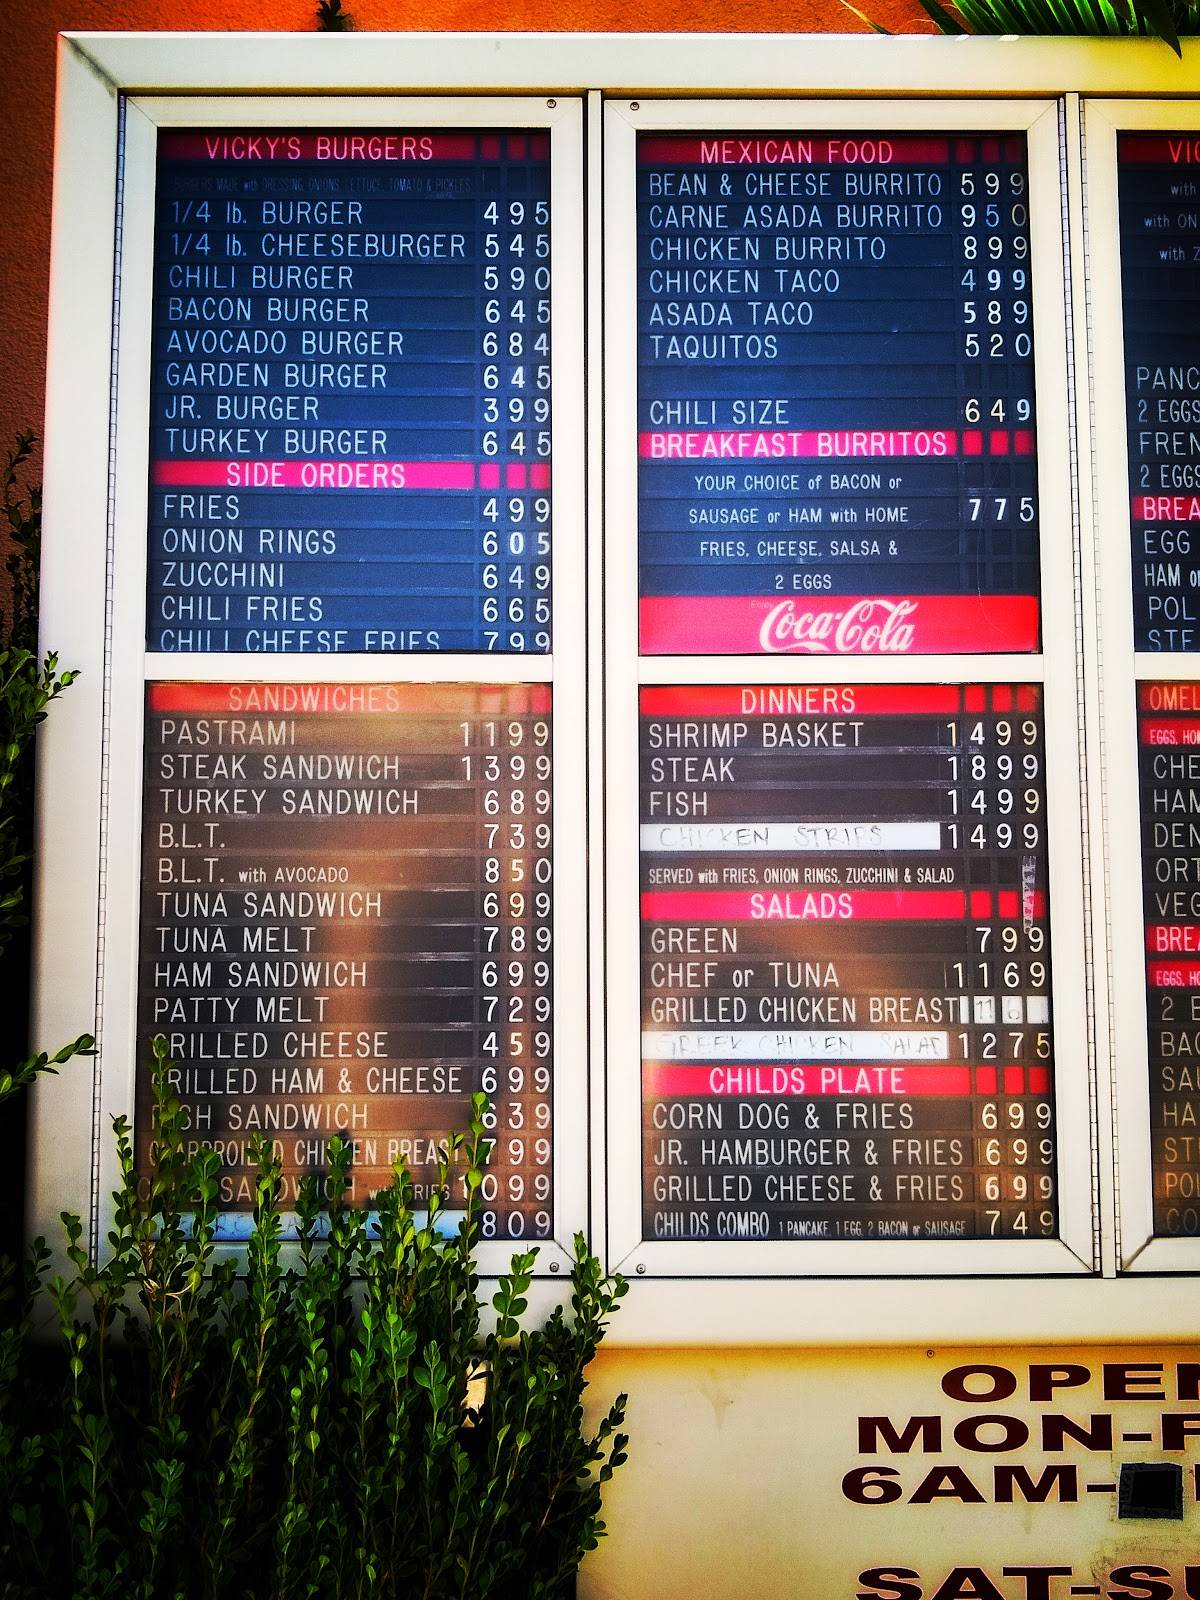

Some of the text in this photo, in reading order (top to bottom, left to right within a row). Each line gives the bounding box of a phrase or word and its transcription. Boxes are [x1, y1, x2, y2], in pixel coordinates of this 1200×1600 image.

[206, 137, 433, 160] VICKY'S BURGERS
[701, 141, 893, 163] MEXICAN FOOD
[650, 174, 941, 196] BEAN & CHEESE BURRITO
[171, 201, 363, 225] 1/4 lb. BURGER
[650, 205, 942, 228] CARNE ASADA BURRITO
[1144, 215, 1170, 228] with
[171, 233, 465, 258] 1/4 lb. CHEESEBURGER
[650, 237, 885, 260] CHICKEN BURRITO
[1160, 246, 1184, 261] with
[169, 266, 353, 289] CHILI BURGER
[650, 270, 840, 293] CHICKEN TACO
[168, 298, 368, 322] BACON BURGER
[650, 302, 813, 326] ASADA TACO
[167, 330, 403, 355] AVOCADO BURGER
[650, 335, 778, 359] TAQUITOS
[166, 363, 387, 388] GARDEN BURGER
[165, 396, 319, 420] JR. BURGER
[650, 400, 789, 425] CHILI SIZE
[1139, 399, 1147, 423] 2
[166, 429, 387, 454] TURKEY BURGER
[651, 432, 947, 458] BREAKFAST BURRITOS
[226, 462, 405, 488] SIDE ORDERS
[695, 475, 902, 490] YOUR CHOICE of BACON or
[1140, 464, 1150, 487] 2
[164, 495, 240, 520] FRIES
[689, 508, 908, 523] SAUSAGE or HAM with HOME
[163, 529, 336, 554] ONION RINGS
[830, 541, 880, 556] SALSA
[888, 541, 898, 555] &
[1144, 530, 1190, 554] EGG
[162, 562, 284, 587] ZUCCHINI
[775, 575, 832, 590] 2 EGGS
[1144, 563, 1180, 587] HAM
[162, 596, 323, 621] CHILI FRIES
[229, 687, 400, 711] SANDWICHES
[741, 689, 855, 714] DINNERS
[162, 720, 296, 745] PASTRAMI
[649, 722, 864, 748] SHRIMP BASKET
[161, 754, 246, 779] STEAK
[263, 755, 399, 780] SANDWICH
[651, 758, 735, 782] STEAK
[160, 789, 418, 814] TURKEY SANDWICH
[650, 791, 707, 816] FISH
[159, 823, 226, 849] B.L.T.
[158, 858, 349, 884] B.L.T. with AVOCADO
[649, 869, 693, 884] SERVED
[698, 869, 718, 884] with
[764, 868, 799, 883] ONION
[846, 868, 899, 883] ZUCCHINI
[904, 868, 911, 883] &
[917, 868, 954, 883] SALAD
[157, 893, 381, 918] TUNA SANDWICH
[750, 893, 852, 919] SALADS
[156, 928, 316, 953] TUNA MELT
[652, 928, 737, 953] GREEN
[155, 961, 366, 987] HAM SANDWICH
[651, 962, 839, 988] CHEF or TUNA
[155, 997, 329, 1023] PATTY MELT
[652, 998, 747, 1023] GRILLED
[759, 997, 856, 1023] CHICKEN
[870, 997, 959, 1023] BREAST
[1161, 996, 1174, 1021] 2
[153, 1032, 390, 1058] GRILLED CHEESE
[271, 1068, 461, 1094] HAM & CHEESE
[710, 1067, 905, 1094] CHILDS PLATE
[229, 1104, 367, 1130] SANDWICH
[653, 1102, 913, 1129] CORN DOG & FRIES
[654, 1139, 962, 1166] JR. HAMBURGER & FRIES
[654, 1175, 963, 1202] GRILLED CHEESE & FRIES
[655, 1212, 966, 1236] CHILDS COMBO BACON or SAUSAGE
